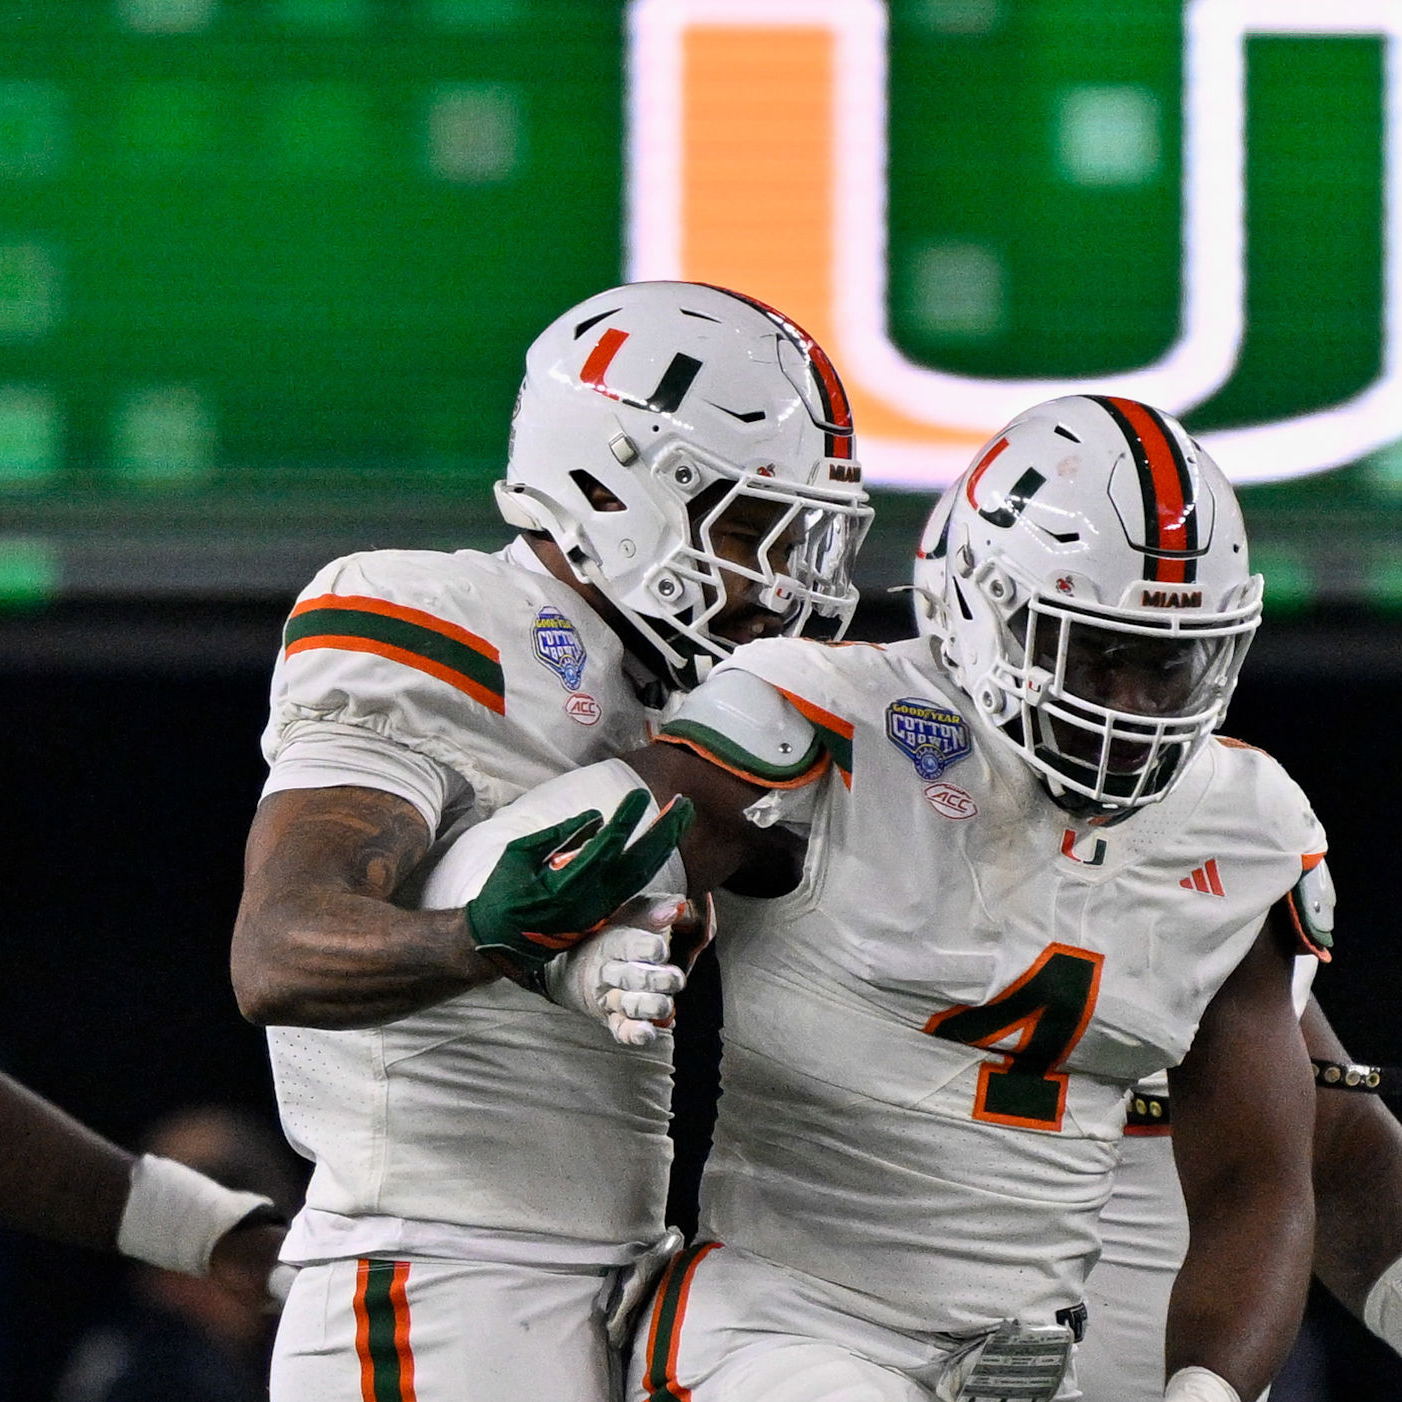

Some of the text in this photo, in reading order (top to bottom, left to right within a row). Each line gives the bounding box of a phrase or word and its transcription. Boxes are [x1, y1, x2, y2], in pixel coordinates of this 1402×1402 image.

[579, 327, 704, 414] U
[829, 463, 861, 483] MIAM
[966, 436, 1047, 529] U
[1141, 589, 1203, 609] MIAMI
[571, 701, 597, 714] ACC
[892, 703, 961, 724] GOODYEAR
[892, 713, 967, 751] COTTON
[906, 731, 953, 753] BOWL
[931, 791, 973, 811] ACC
[1061, 828, 1108, 866] U
[922, 941, 1105, 1132] 4
